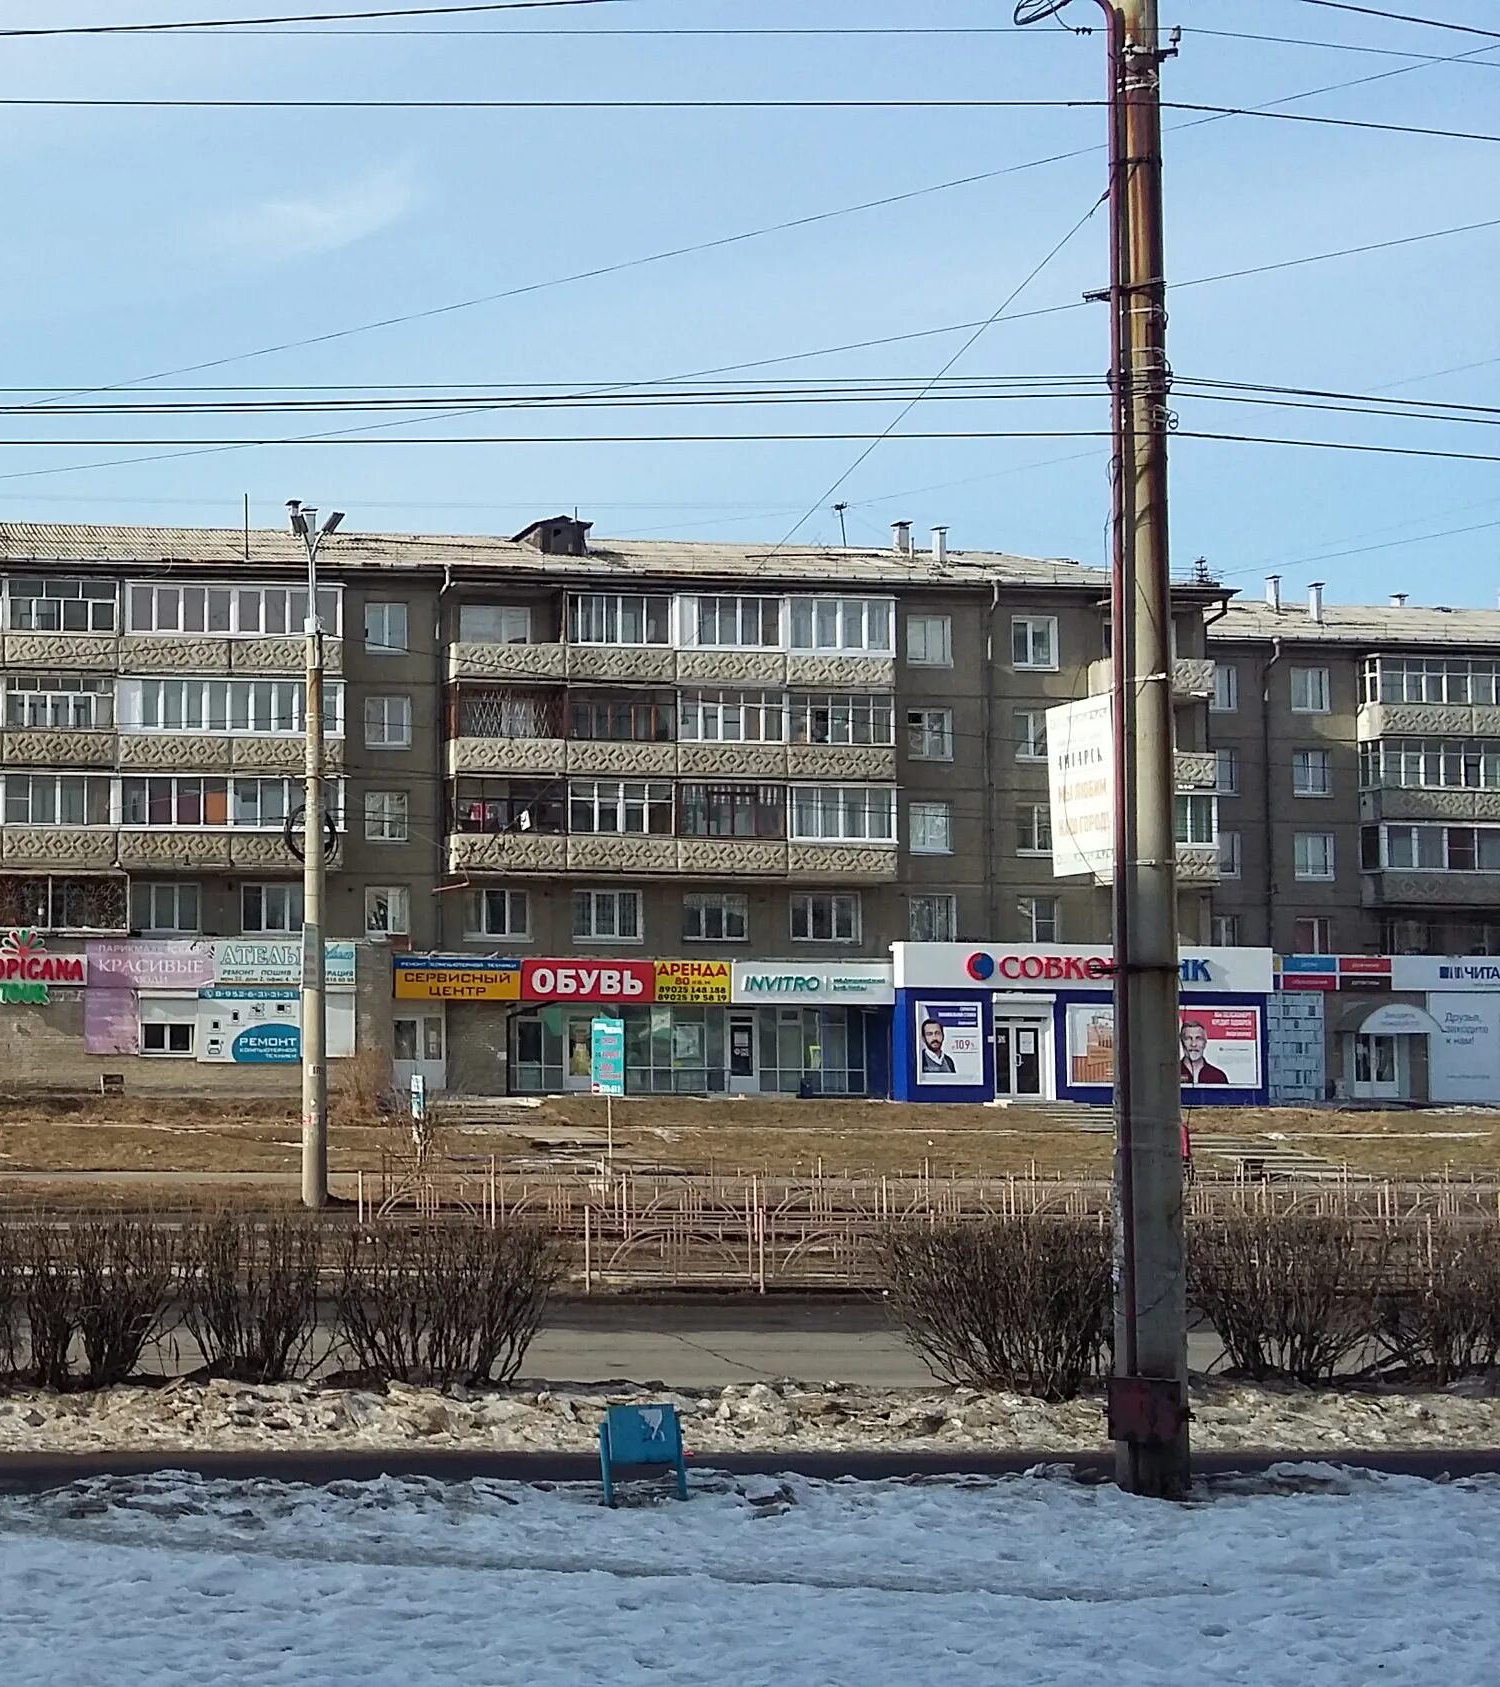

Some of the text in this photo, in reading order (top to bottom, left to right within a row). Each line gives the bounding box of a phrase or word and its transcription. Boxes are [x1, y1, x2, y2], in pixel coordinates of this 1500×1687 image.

[99, 959, 204, 974] КРАСИВЫЕ
[657, 963, 728, 978] АРЕНДА
[404, 972, 511, 984] СЕРВИСНЫЙ
[531, 968, 643, 996] ОБУВЬ
[674, 977, 690, 985] 80
[743, 975, 820, 991] INVITRO
[429, 986, 486, 996] ЦЕНТР
[240, 1037, 297, 1046] РЕМОНТ
